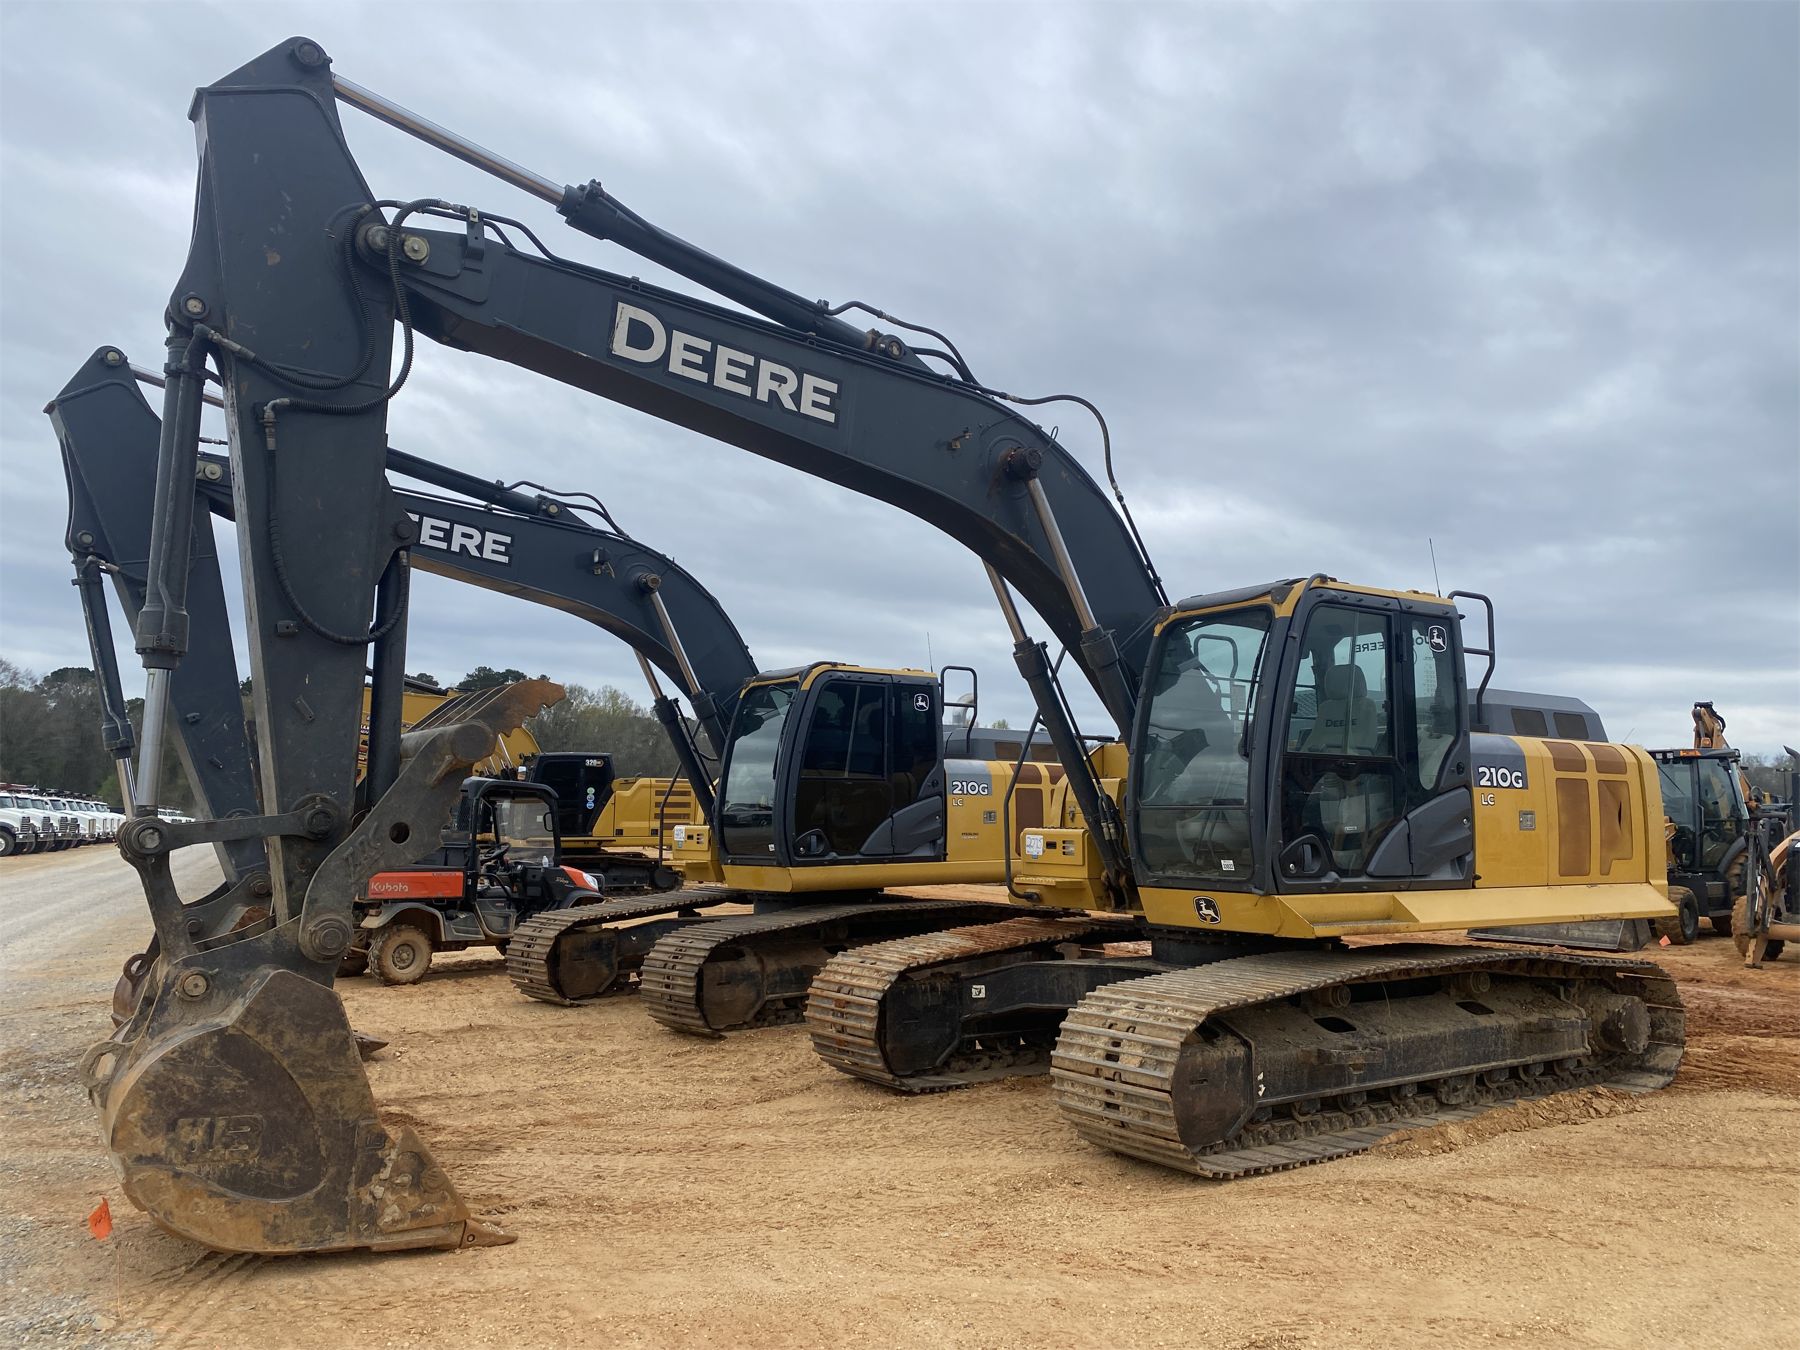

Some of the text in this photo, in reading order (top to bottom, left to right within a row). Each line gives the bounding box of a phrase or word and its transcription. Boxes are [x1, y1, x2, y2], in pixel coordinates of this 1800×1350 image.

[612, 302, 838, 423] DEERE
[407, 510, 512, 564] ERE
[1477, 766, 1524, 789] 210G
[952, 780, 989, 796] 210G
[952, 798, 964, 806] LC
[1481, 793, 1495, 806] LC
[371, 882, 409, 892] Kubota
